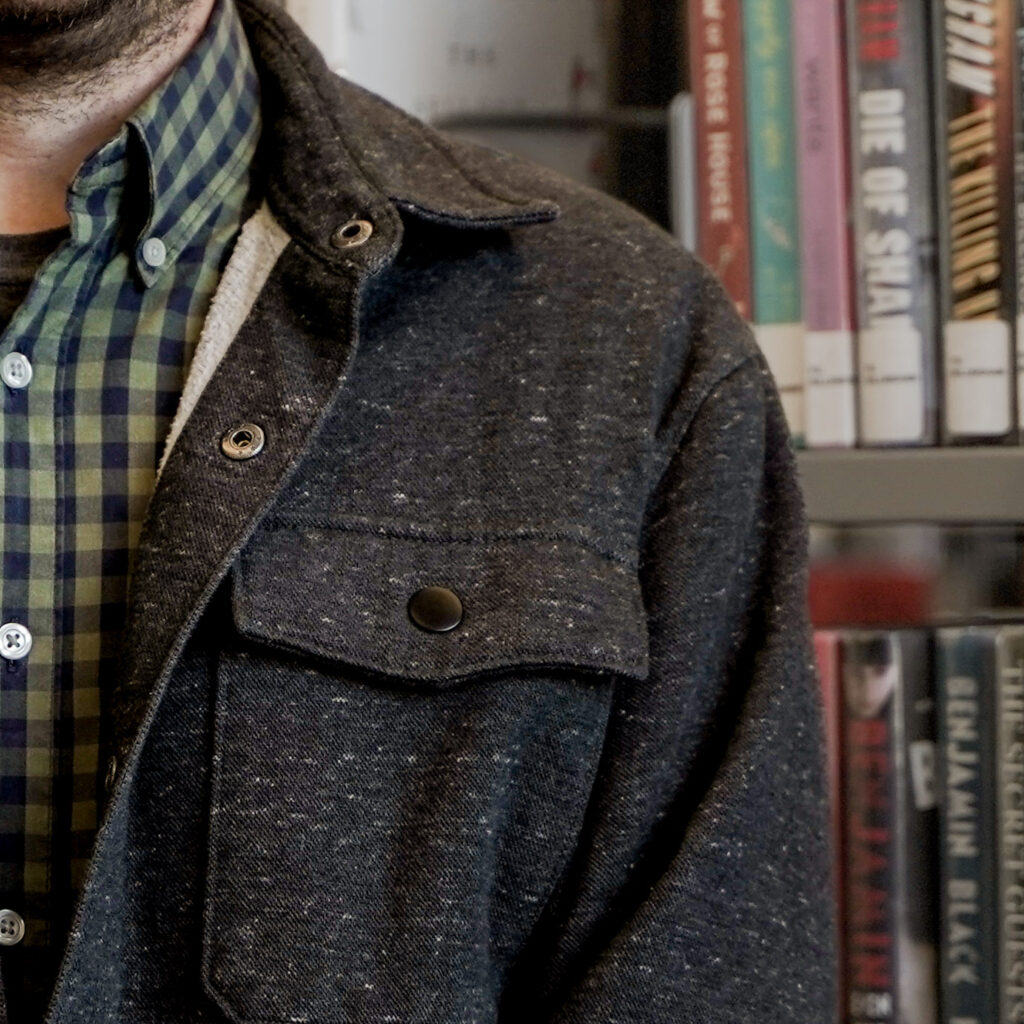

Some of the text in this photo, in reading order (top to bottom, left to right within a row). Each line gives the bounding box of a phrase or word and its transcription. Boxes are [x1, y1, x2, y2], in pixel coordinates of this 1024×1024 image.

[704, 22, 722, 48] OF
[704, 52, 729, 125] ROSE
[858, 88, 907, 154] DIE
[948, 104, 996, 168] THE
[707, 130, 733, 224] HOUSE
[862, 166, 911, 218] OF
[951, 165, 1001, 293] KILLING
[946, 675, 980, 859] BENJAMIN
[947, 878, 981, 986] BLACK
